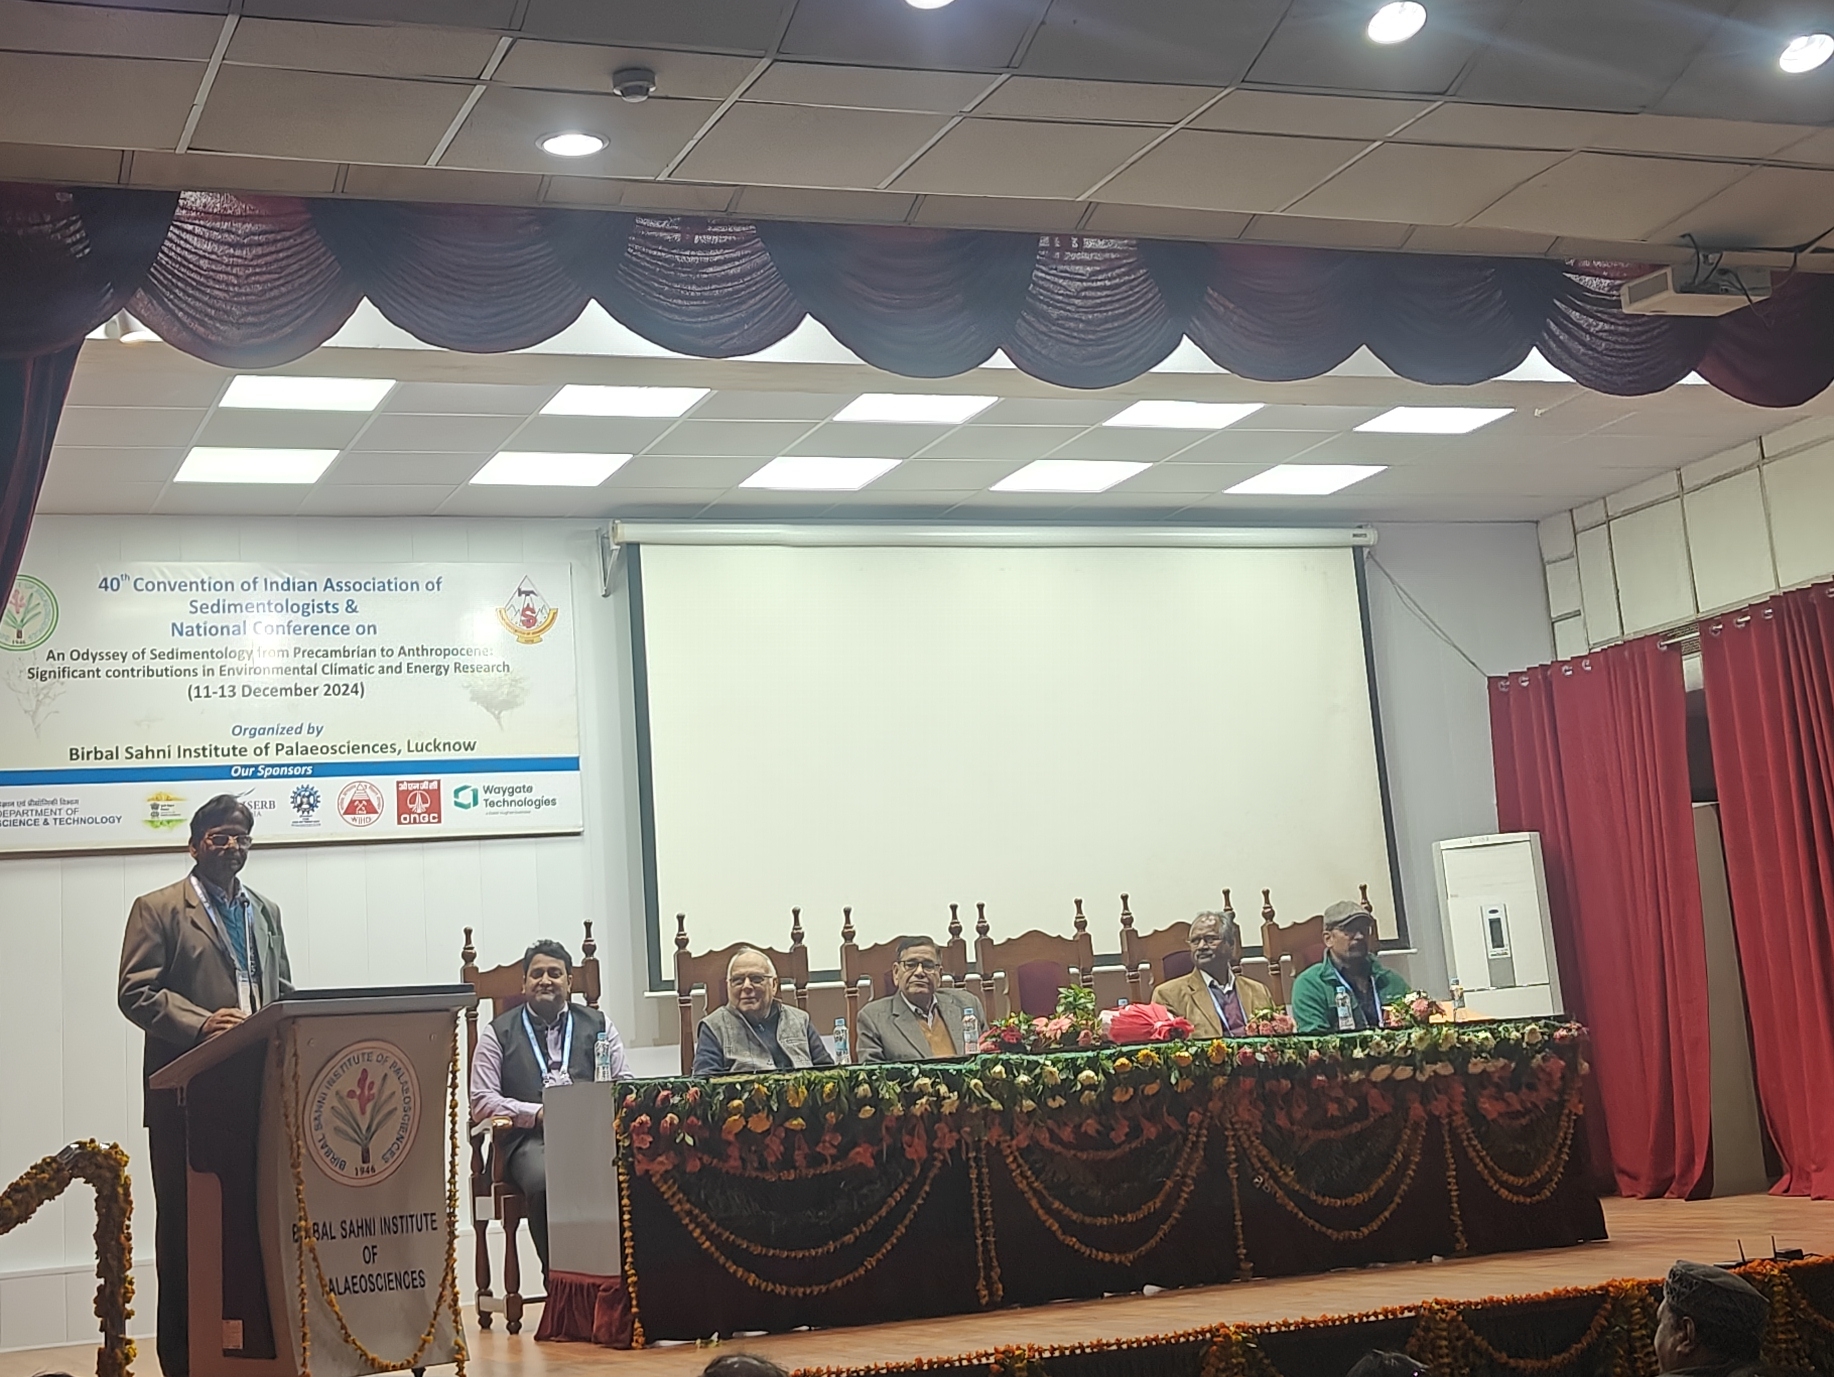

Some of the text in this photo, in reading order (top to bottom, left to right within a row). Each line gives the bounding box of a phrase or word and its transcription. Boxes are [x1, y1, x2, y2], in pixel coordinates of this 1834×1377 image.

[98, 573, 443, 592] 40th Convention of Indian Association of
[189, 598, 359, 617] Sedimentologists &
[171, 618, 377, 637] National Conference on
[46, 645, 493, 664] An Odyssey of Sedimentology from Precambrian to Anthropocene:
[28, 660, 510, 682] Significant contributions in Environmental Climatic and Energy Research
[188, 681, 365, 702] (11-13 December 2024)
[232, 723, 324, 738] Organized by
[69, 738, 476, 761] Birbal Sahni Institute of Palaeosciences, Lucknow
[231, 764, 312, 778] Our Sponsors
[483, 784, 533, 797] Waygate
[483, 795, 557, 809] Technologies
[0, 816, 122, 828] CIENCE & TECHNOLOGY
[66, 808, 79, 817] OF
[376, 1053, 389, 1063] OF
[325, 1052, 373, 1090] INSTITUTE
[313, 1092, 327, 1131] SAHNI
[318, 1134, 347, 1171] BIRBAL
[355, 1166, 376, 1176] 1946
[292, 1212, 438, 1243] BBAL SAHNI INSTITUTE
[363, 1245, 378, 1264] OF
[326, 1269, 426, 1296] ALAEOSCIENCES
